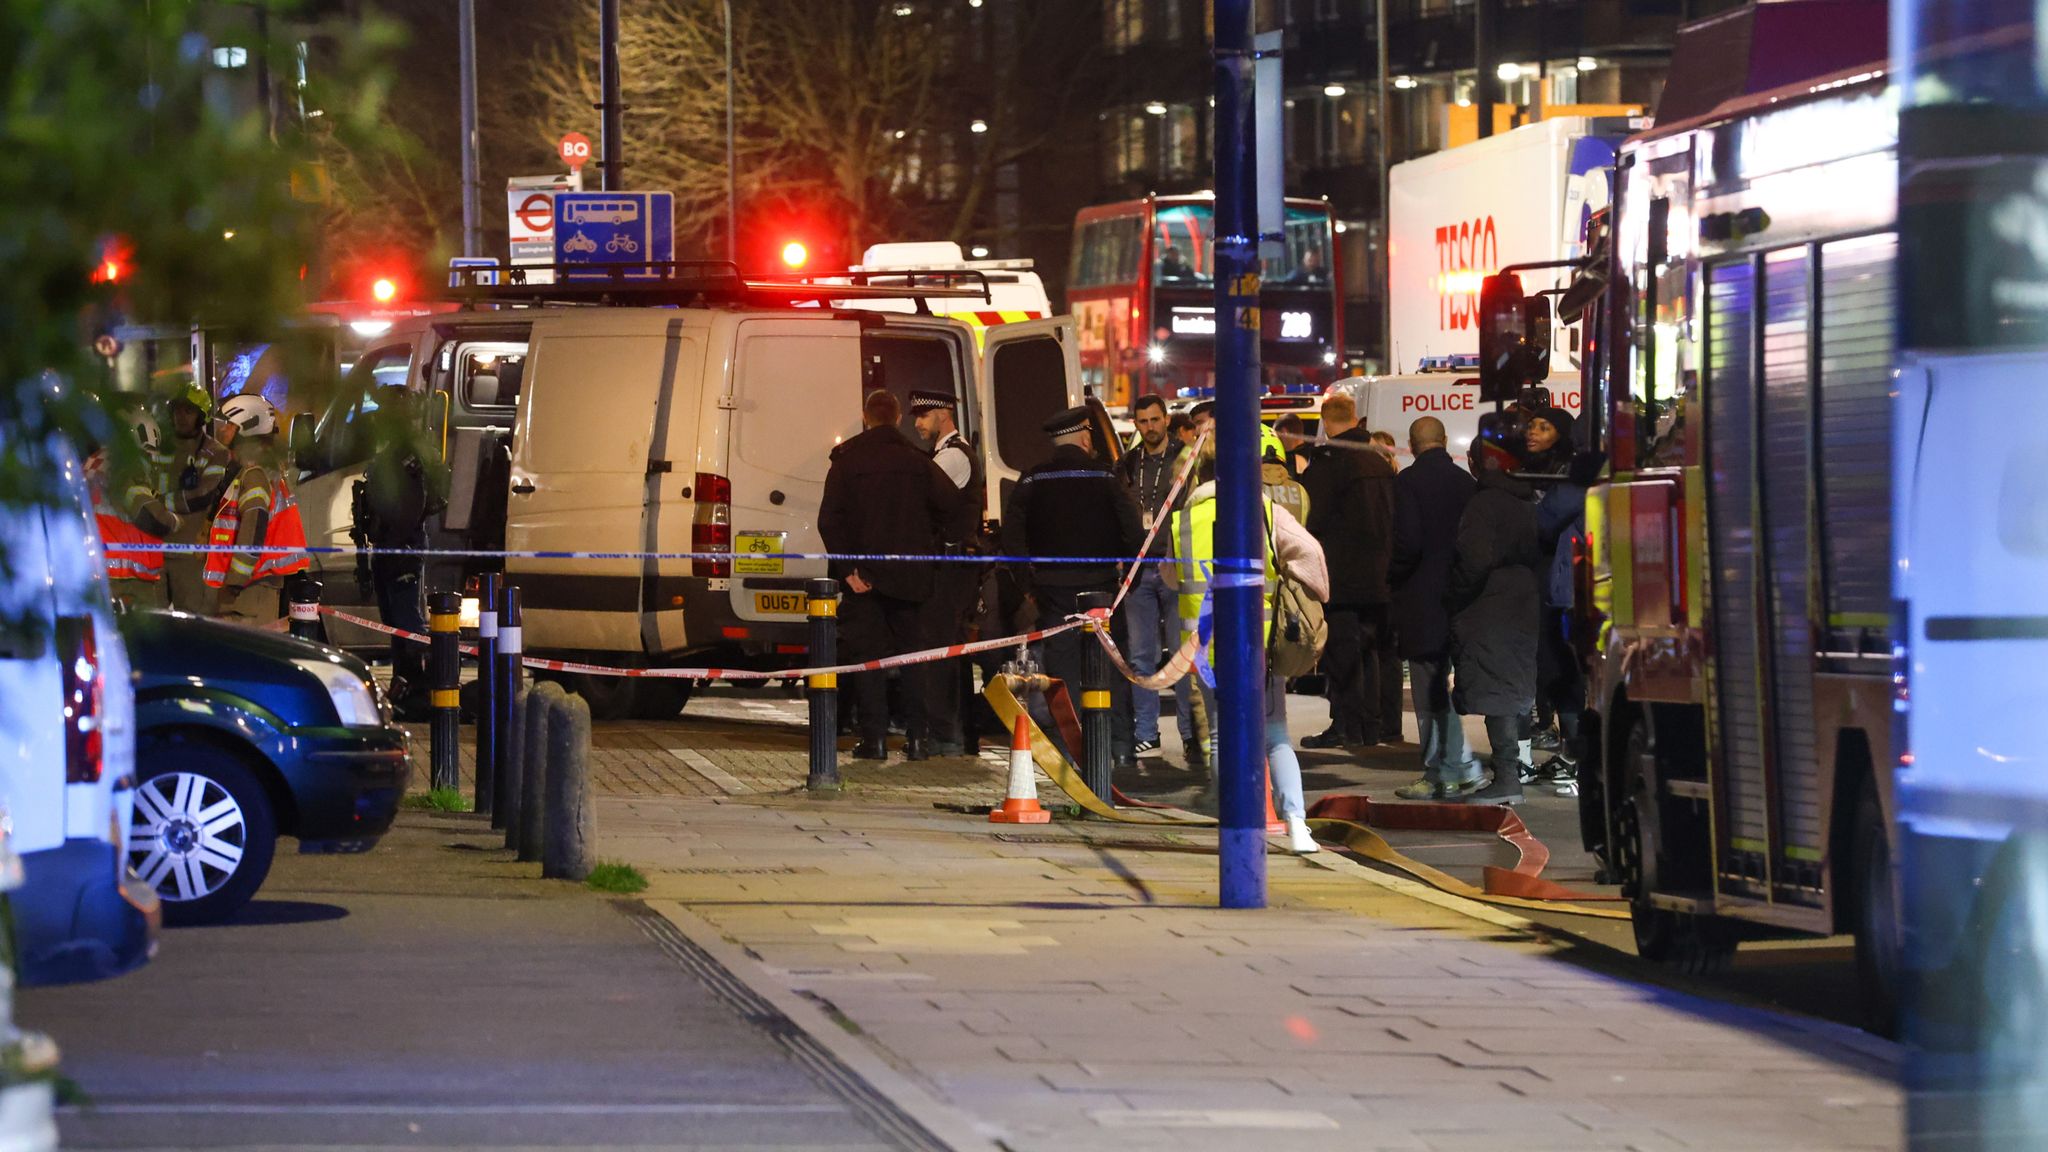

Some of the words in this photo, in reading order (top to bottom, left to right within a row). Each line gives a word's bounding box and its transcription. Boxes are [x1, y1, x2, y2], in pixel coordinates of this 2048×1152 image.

[563, 142, 588, 157] BQ
[1435, 215, 1498, 331] TESCO
[1402, 393, 1474, 412] POLICE
[1550, 391, 1581, 409] LIC
[761, 595, 799, 611] OU67
